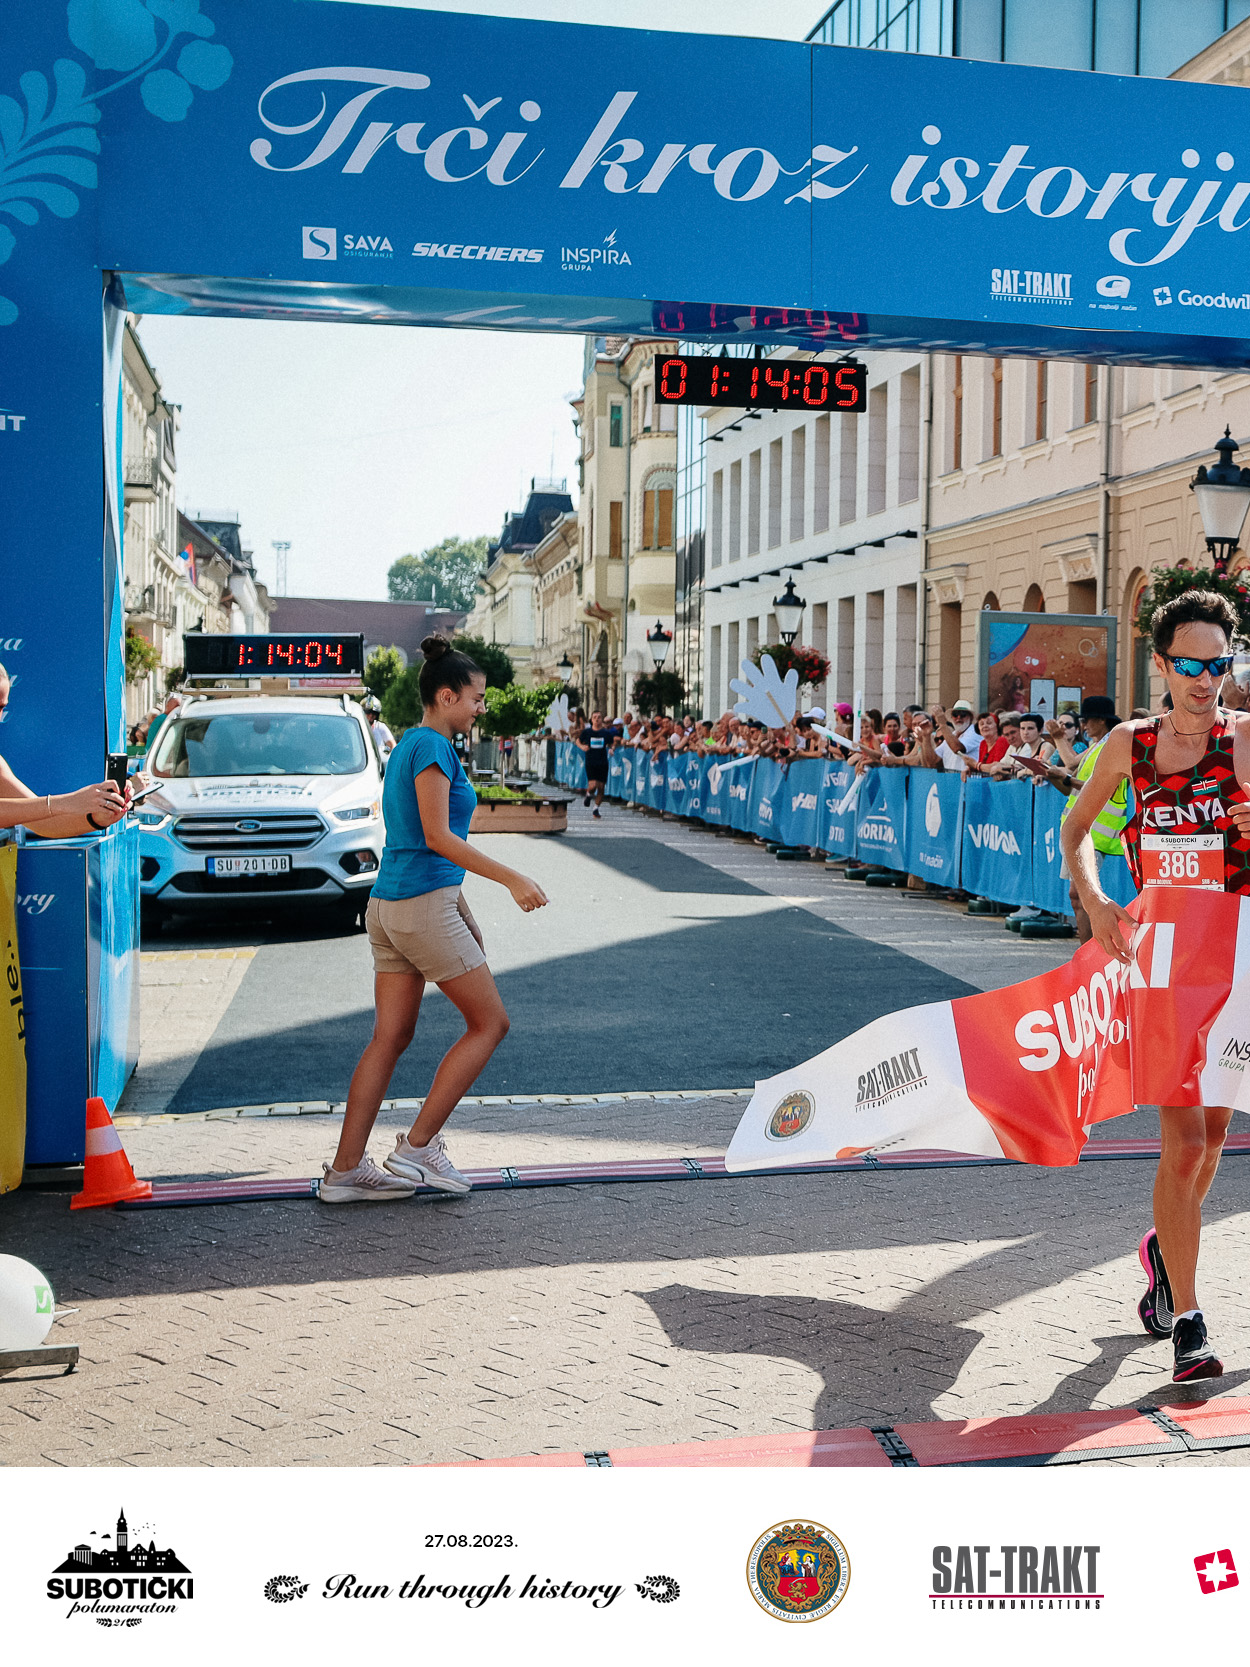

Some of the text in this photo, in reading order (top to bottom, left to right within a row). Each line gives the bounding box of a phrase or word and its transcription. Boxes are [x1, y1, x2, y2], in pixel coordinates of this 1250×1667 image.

[249, 66, 545, 187] Trči
[559, 90, 869, 205] kroz
[343, 234, 394, 252] SAVA
[411, 242, 545, 263] SKECHERS
[561, 246, 632, 266] INSPIRA
[561, 263, 592, 272] GRUPA
[991, 268, 1073, 298] SAT-TRAKT
[1142, 798, 1226, 828] KENYA
[217, 859, 233, 871] SU
[1158, 851, 1200, 878] 386
[1218, 1058, 1245, 1073] GRUPA
